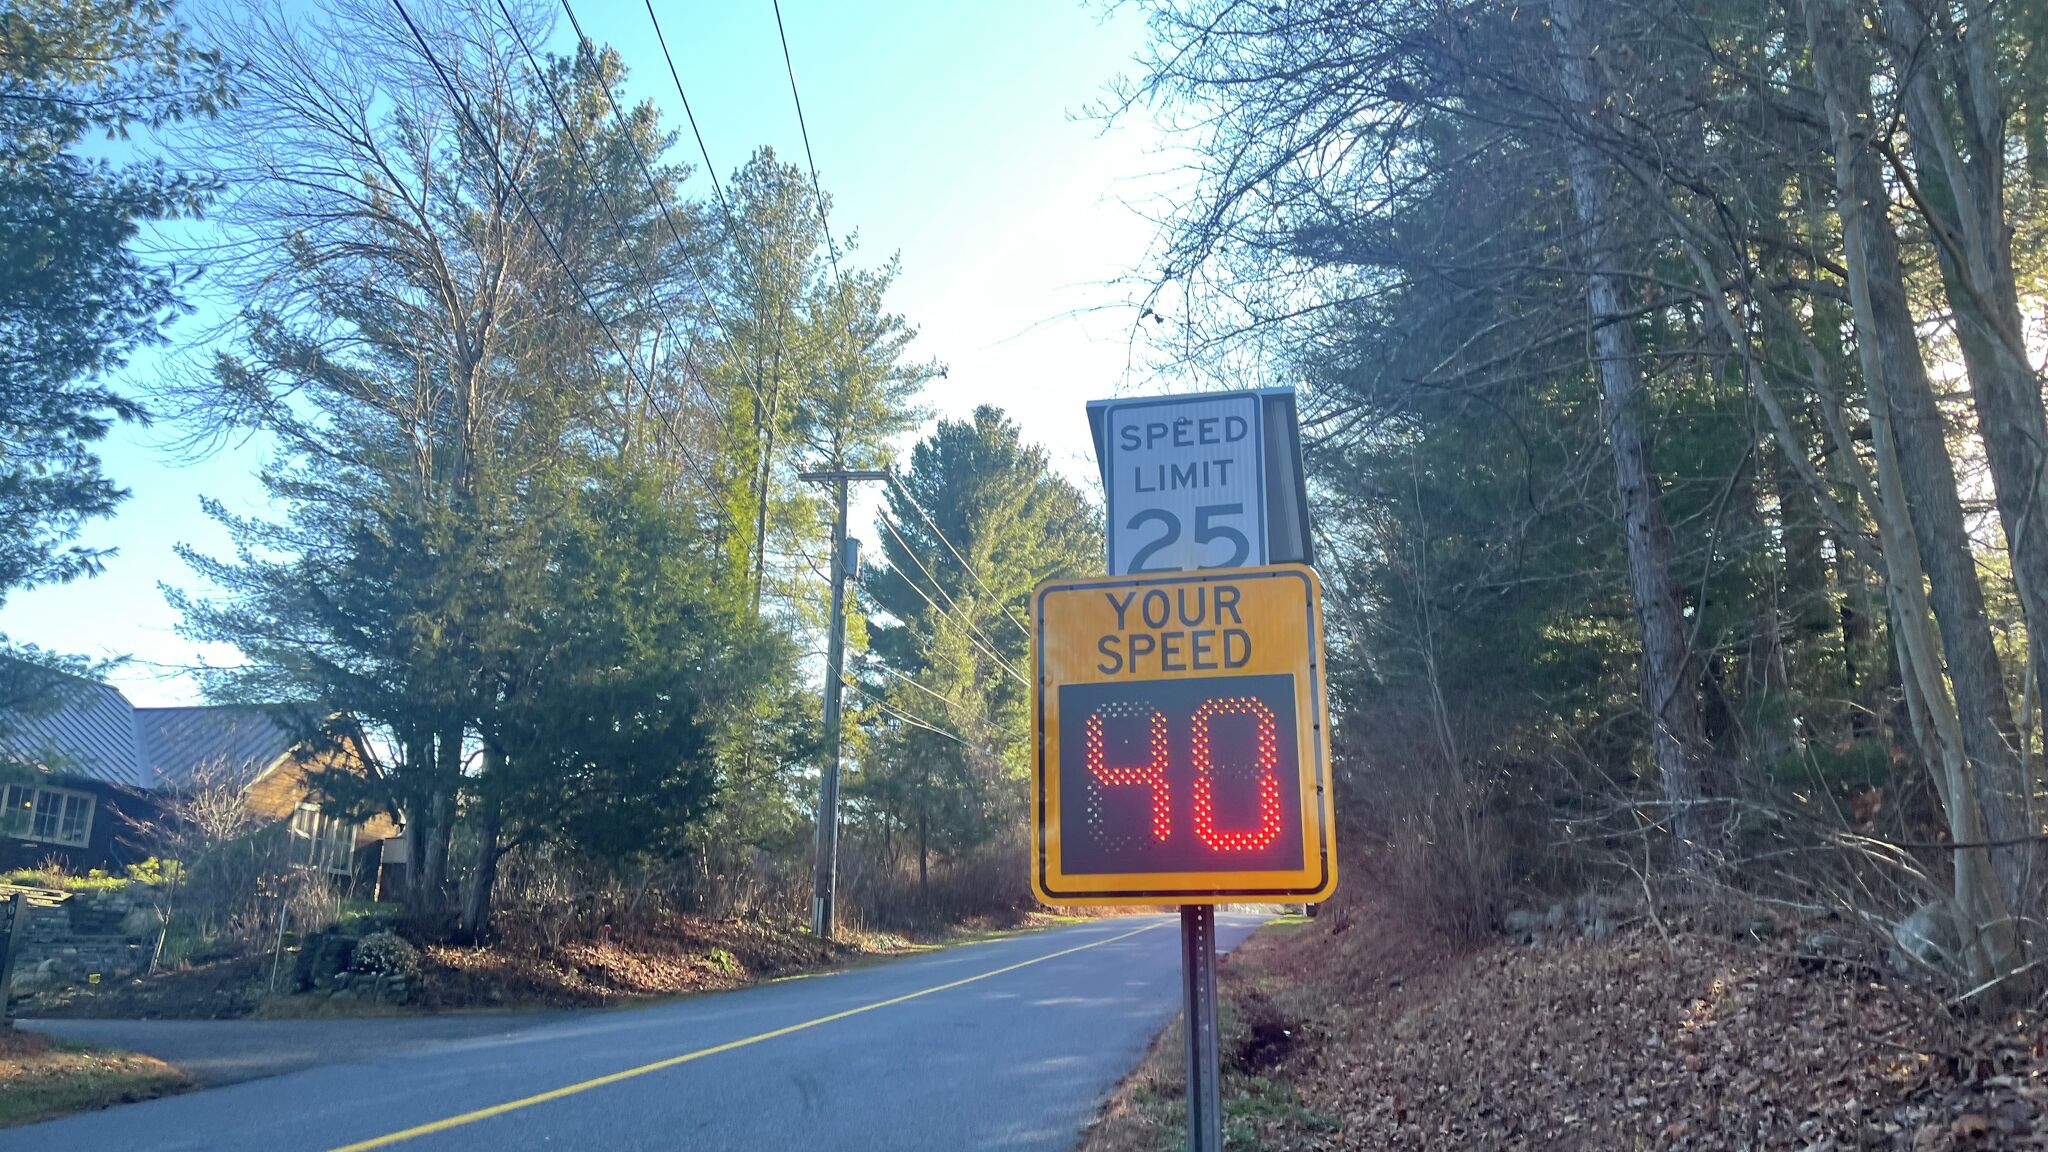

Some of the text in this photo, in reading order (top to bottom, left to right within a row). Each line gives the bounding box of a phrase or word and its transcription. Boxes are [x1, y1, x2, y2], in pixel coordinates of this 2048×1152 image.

[1120, 416, 1248, 451] SPEED
[1134, 459, 1234, 493] LIMIT
[1126, 503, 1250, 575] 25
[1106, 585, 1242, 631] YOUR
[1097, 628, 1251, 675] SPEED
[1086, 695, 1282, 851] 40
